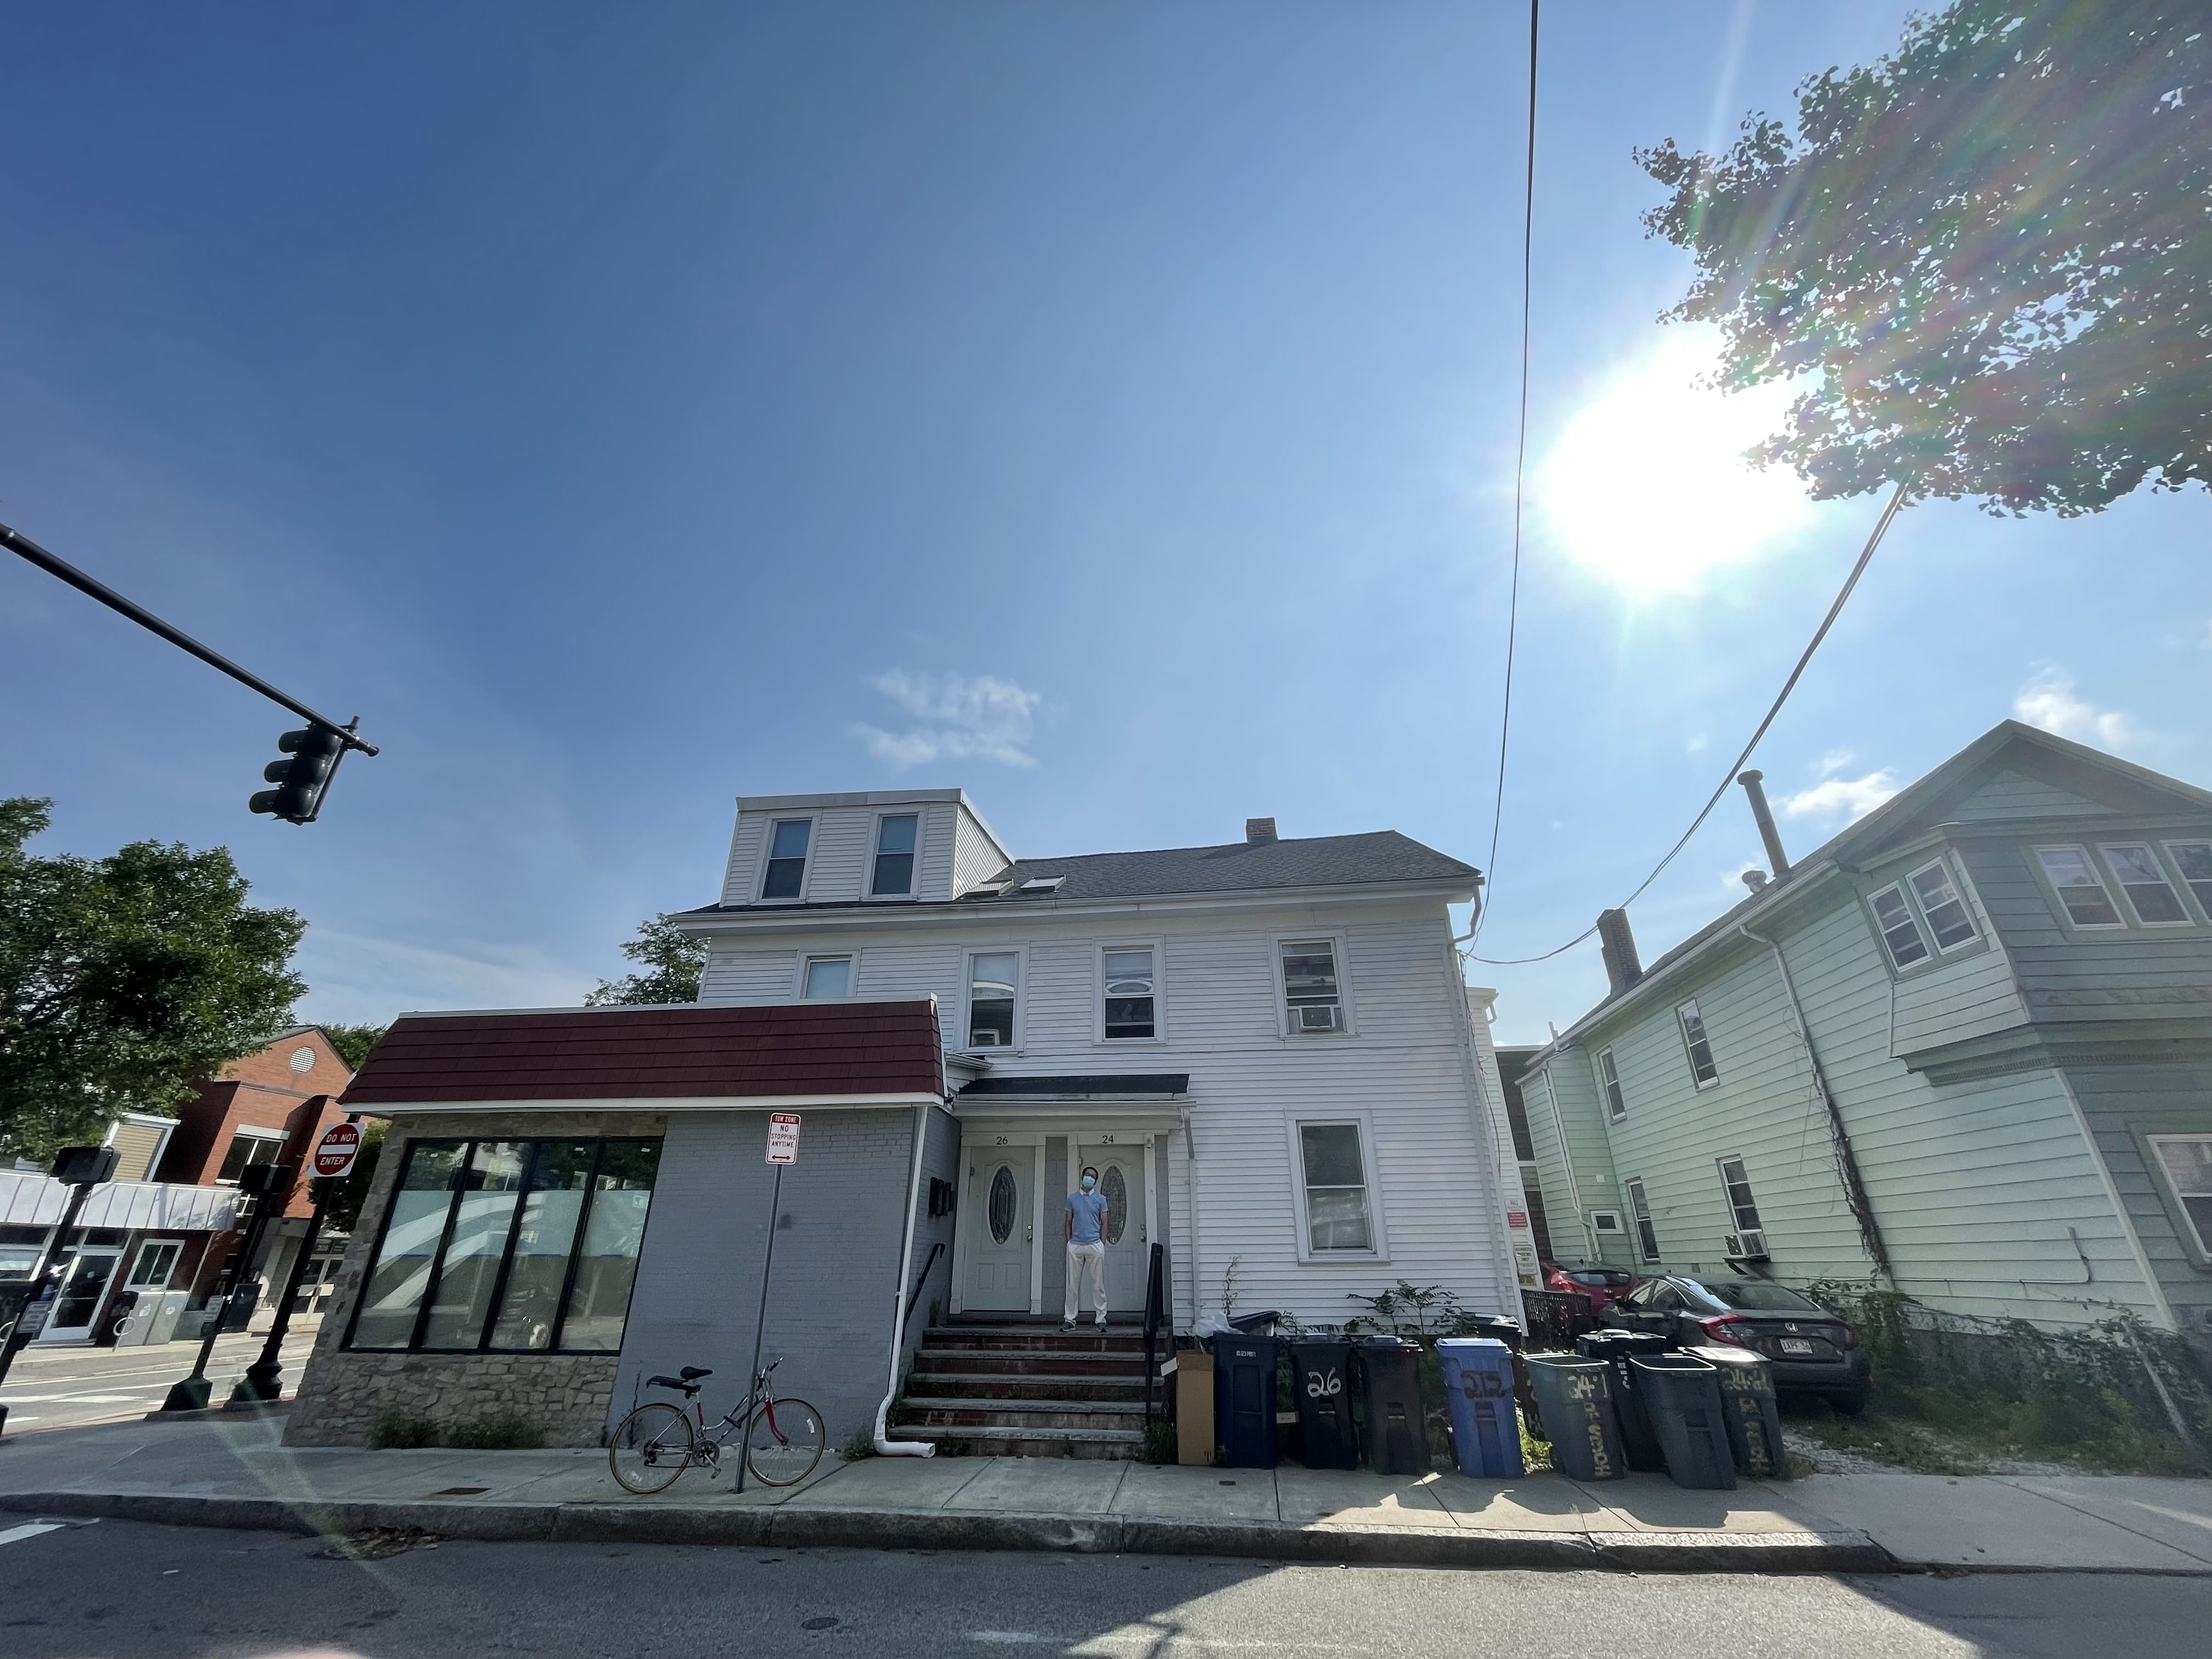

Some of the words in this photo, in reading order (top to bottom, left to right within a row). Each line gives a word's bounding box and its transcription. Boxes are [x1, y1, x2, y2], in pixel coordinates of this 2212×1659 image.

[326, 1134, 337, 1142] DO
[341, 1133, 357, 1142] NOT
[996, 1136, 1008, 1145] 26
[1102, 1135, 1114, 1144] 24
[320, 1156, 345, 1165] ENTER
[1307, 1367, 1341, 1397] 26
